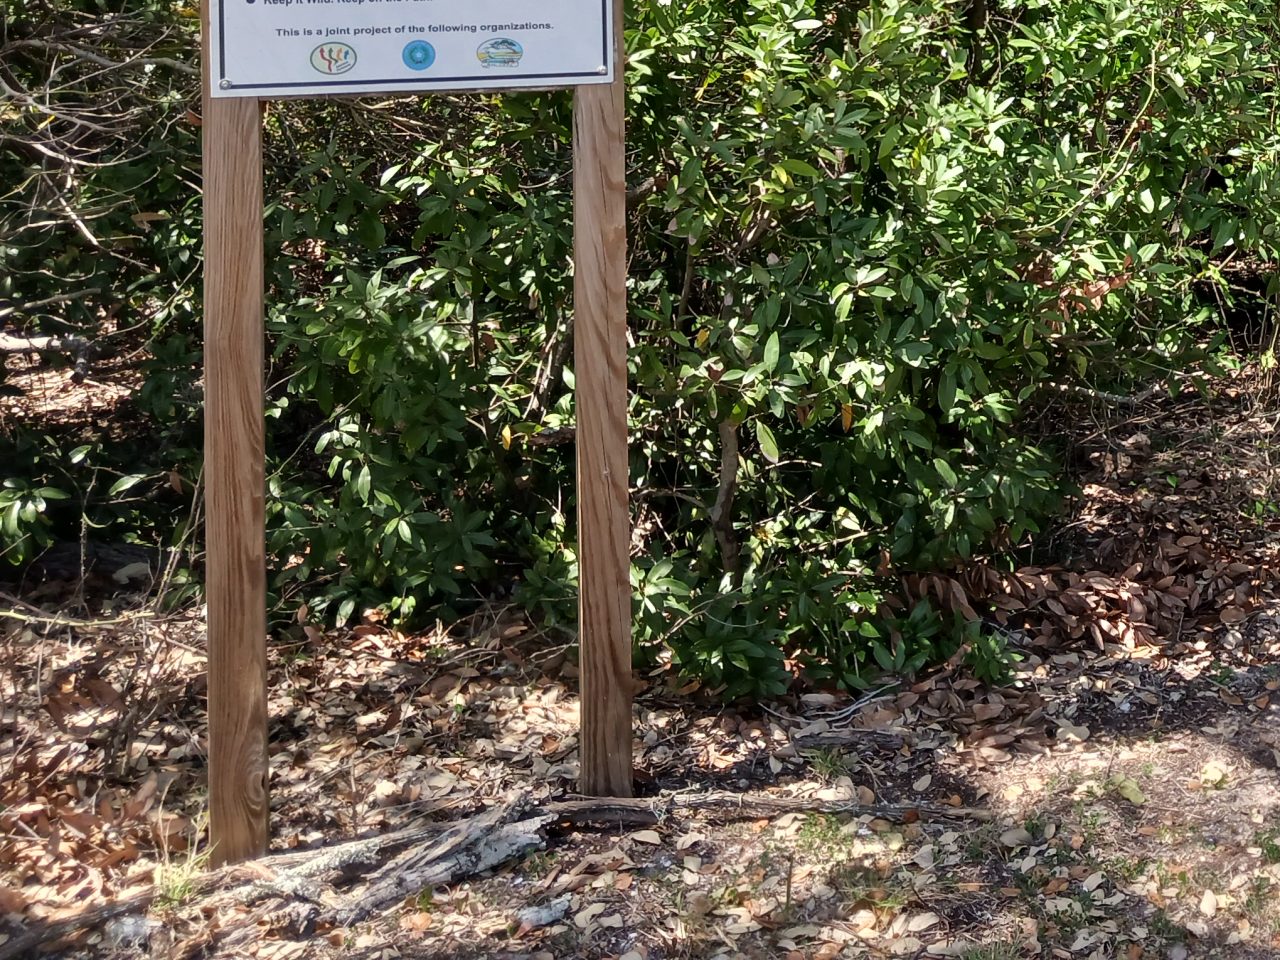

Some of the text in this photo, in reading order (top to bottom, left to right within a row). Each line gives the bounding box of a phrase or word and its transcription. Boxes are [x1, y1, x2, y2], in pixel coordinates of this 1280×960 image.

[274, 28, 300, 36] This
[303, 28, 312, 36] is
[324, 27, 350, 37] joint
[353, 26, 391, 36] project
[394, 25, 406, 33] of
[427, 24, 476, 33] following
[479, 22, 554, 32] organizations.
